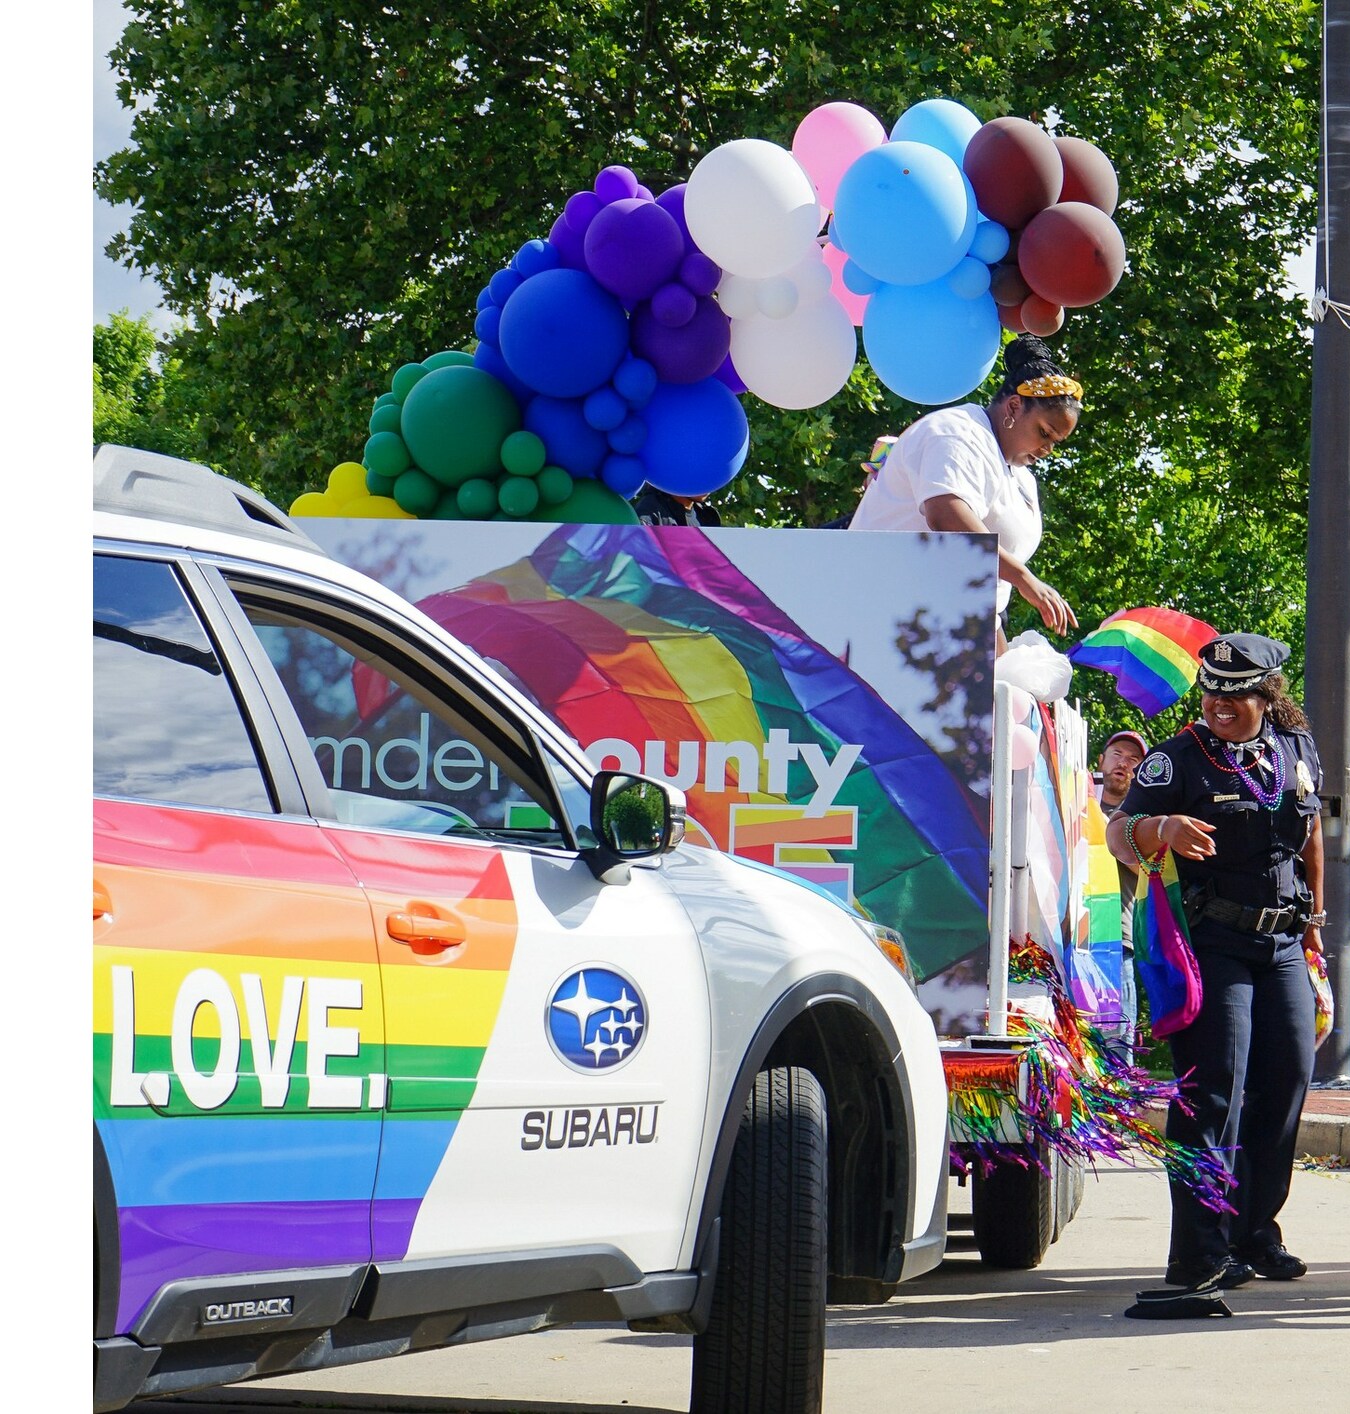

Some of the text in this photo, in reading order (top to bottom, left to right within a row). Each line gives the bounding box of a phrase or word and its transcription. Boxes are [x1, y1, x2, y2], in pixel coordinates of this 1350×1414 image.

[584, 728, 865, 818] ounty
[110, 965, 387, 1110] LOVE.
[520, 1105, 659, 1151] SUBARU
[206, 1297, 290, 1321] OUTBACK
